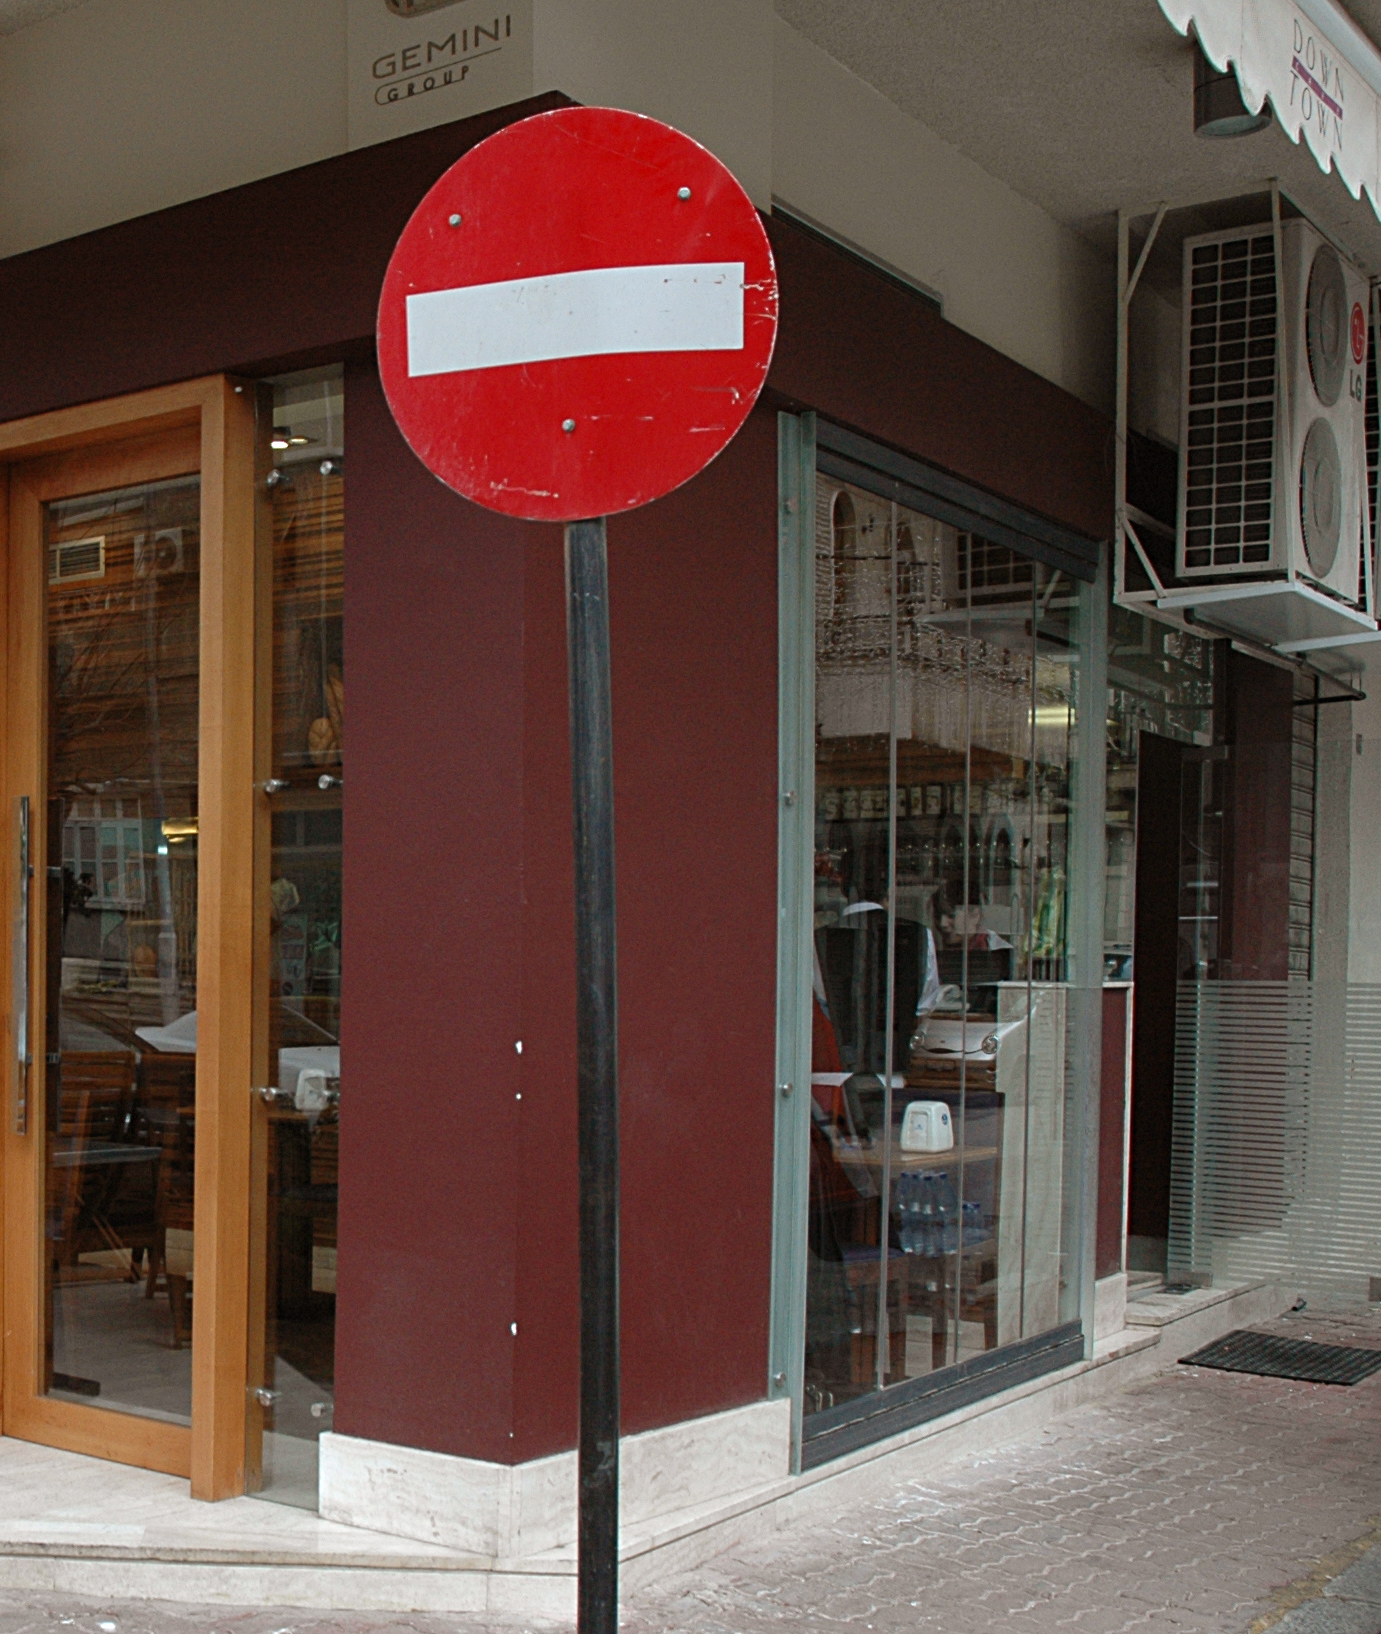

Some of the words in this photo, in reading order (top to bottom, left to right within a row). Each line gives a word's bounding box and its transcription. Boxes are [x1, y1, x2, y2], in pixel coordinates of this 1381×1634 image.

[372, 14, 512, 80] GEMINI
[1294, 18, 1344, 102] DOWN
[387, 65, 470, 102] GROUP
[1290, 69, 1343, 151] TOWN
[1350, 368, 1362, 403] LG
